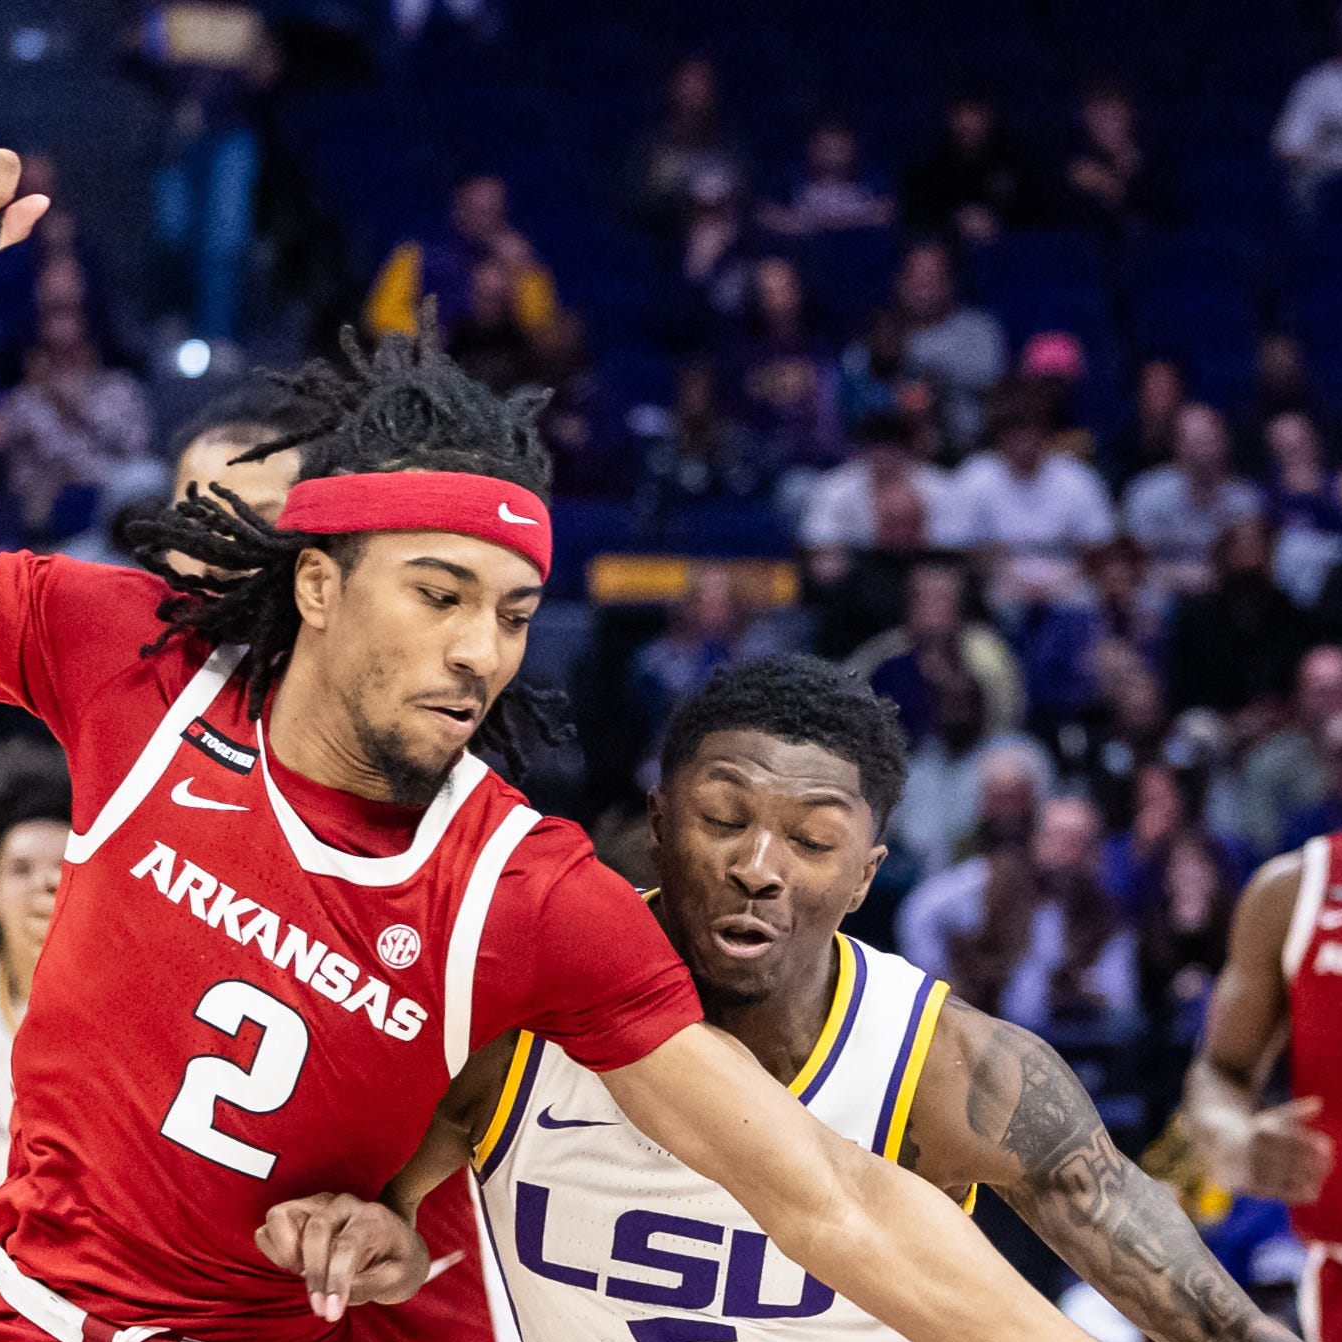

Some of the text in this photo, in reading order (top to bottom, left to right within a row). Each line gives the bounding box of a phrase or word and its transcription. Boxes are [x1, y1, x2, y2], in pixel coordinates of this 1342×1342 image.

[129, 839, 430, 1043] ARKANSAS
[379, 927, 419, 967] SEC
[160, 978, 309, 1180] 2
[515, 1180, 835, 1319] LSU
